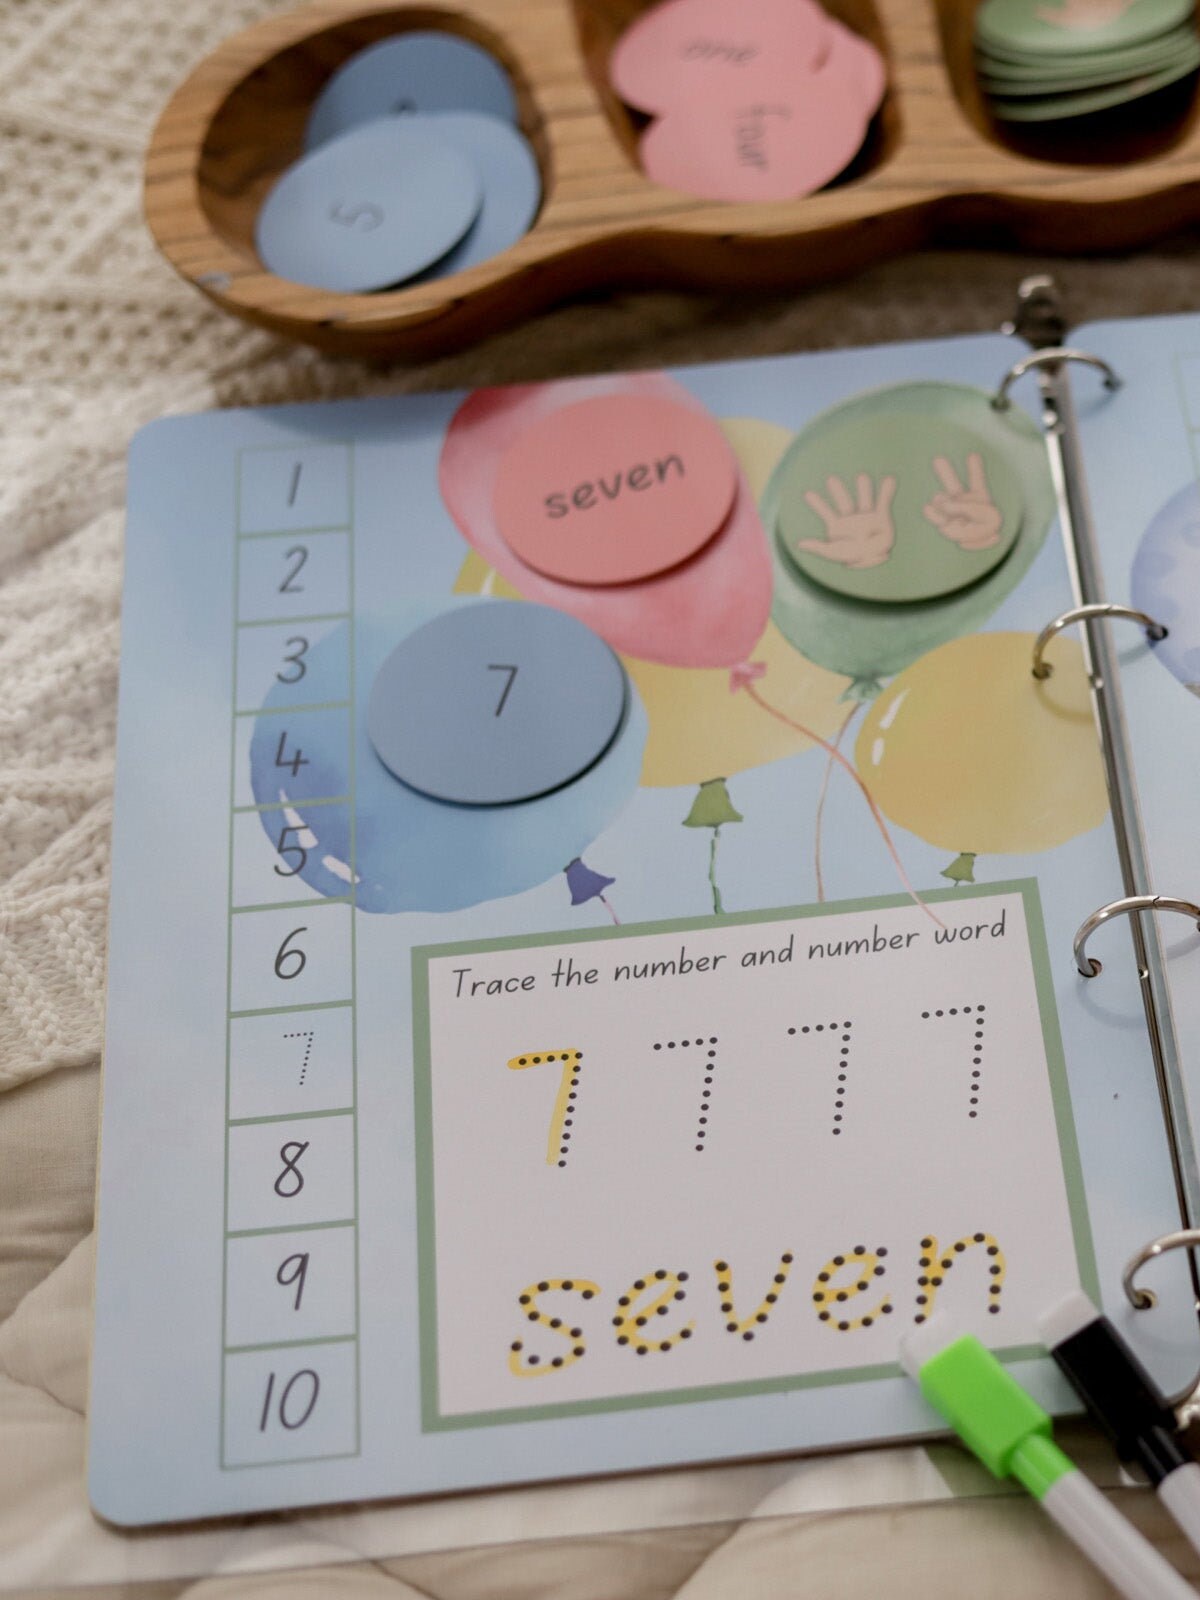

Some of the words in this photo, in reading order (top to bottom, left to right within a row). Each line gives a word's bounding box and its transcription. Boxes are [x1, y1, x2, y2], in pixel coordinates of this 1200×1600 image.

[734, 103, 793, 173] four
[287, 463, 303, 507] 1
[543, 454, 685, 519] seven
[278, 545, 309, 594] 2
[276, 636, 309, 685] 3
[487, 664, 519, 718] 7
[274, 731, 310, 778] 4
[273, 825, 309, 878] 5
[274, 926, 308, 980] 6
[452, 968, 536, 998] Trace
[551, 958, 599, 988] the
[614, 945, 727, 982] number
[740, 933, 794, 968] and
[808, 924, 920, 960] number
[934, 908, 1006, 945] word
[283, 1031, 315, 1086] 7
[507, 1048, 584, 1168] 7
[653, 1036, 718, 1152] 7
[787, 1020, 853, 1136] 7
[921, 1004, 986, 1119] 7
[273, 1141, 310, 1198] 8
[276, 1252, 310, 1311] 9
[508, 1231, 1006, 1379] seven
[259, 1369, 320, 1433] 10
